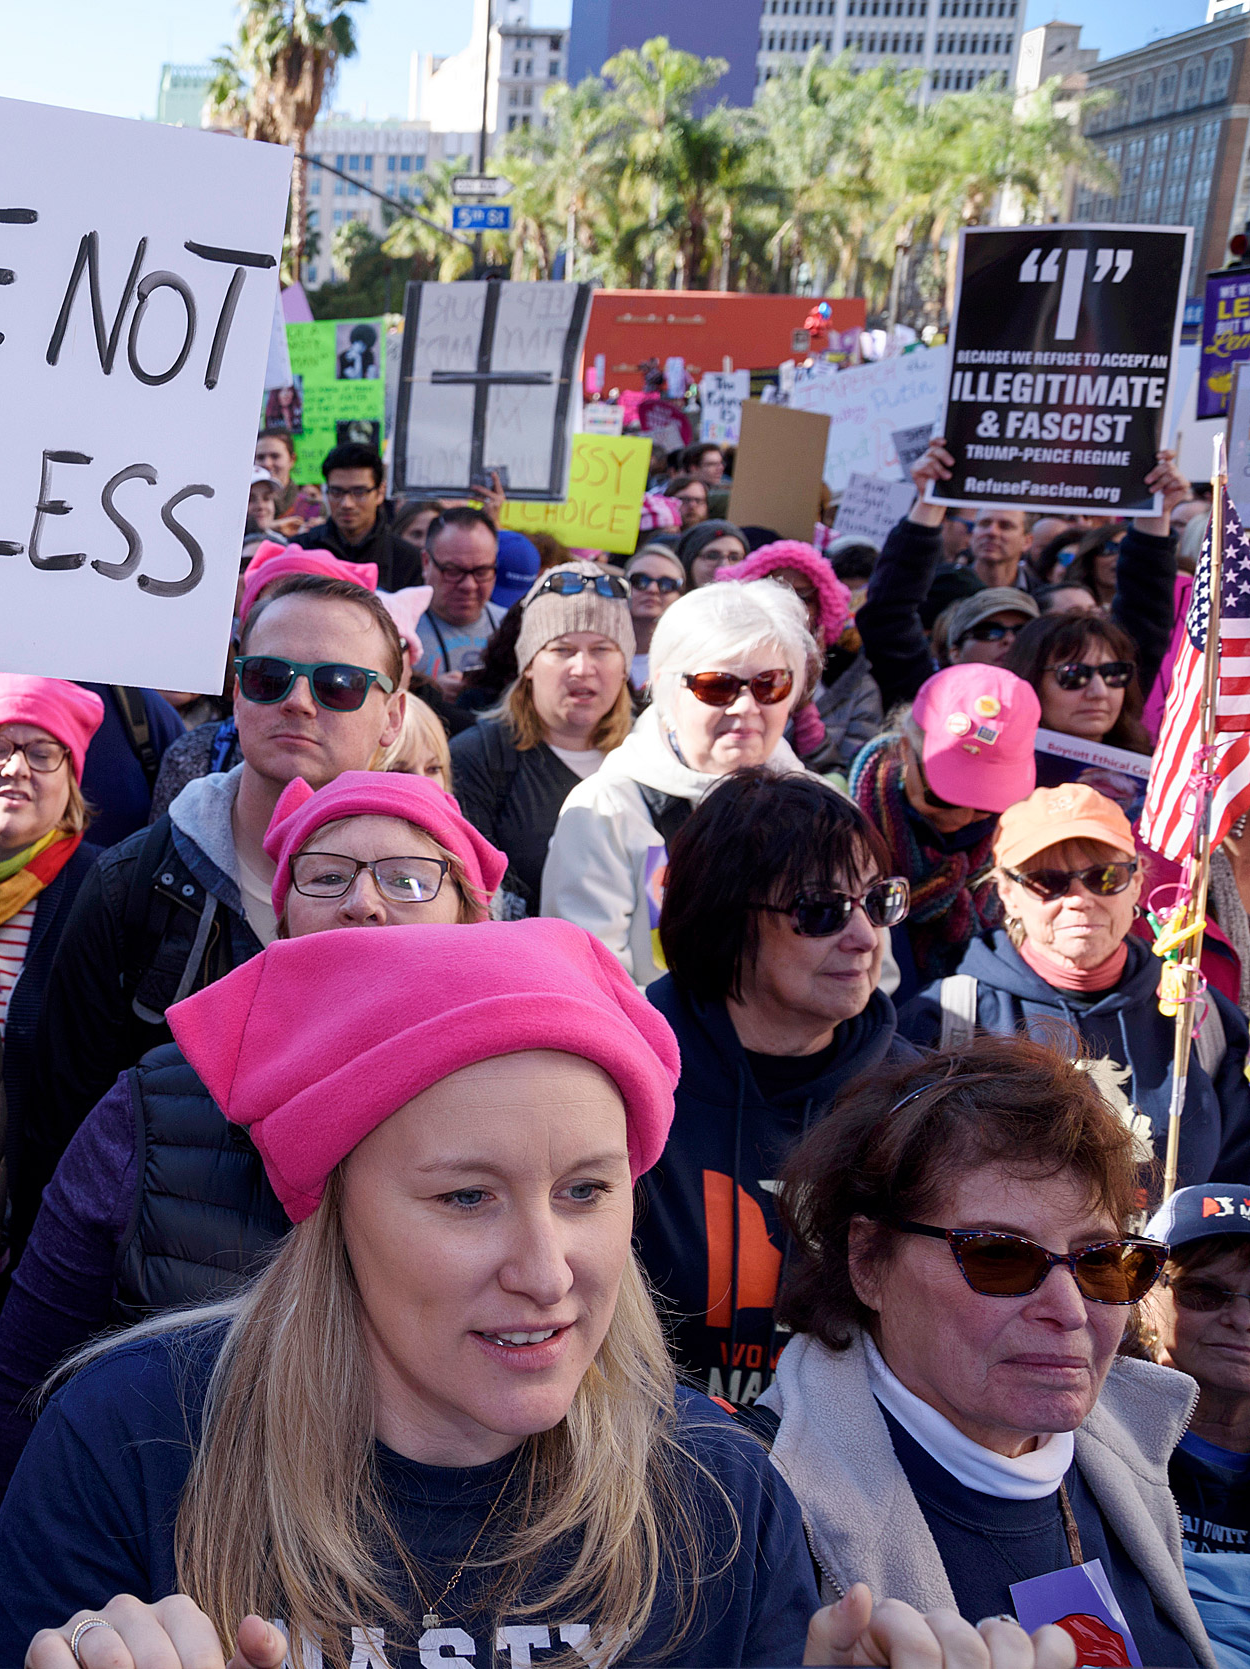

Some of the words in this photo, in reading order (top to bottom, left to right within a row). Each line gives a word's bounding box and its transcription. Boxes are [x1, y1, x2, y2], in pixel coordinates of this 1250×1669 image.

[46, 229, 278, 390] NOT
[956, 350, 1011, 365] BECAUSE
[1011, 351, 1033, 365] WE
[1033, 352, 1082, 367] REFUSE
[1083, 353, 1100, 366] TO
[1101, 353, 1150, 368] ACCEPT
[1150, 355, 1168, 369] AN
[951, 371, 1165, 408] ILLEGITIMATE
[976, 410, 1000, 438] &
[1005, 411, 1132, 443] FASCIST
[966, 444, 1072, 464] TRUMP-PENCE
[1073, 449, 1131, 466] REGIME
[964, 477, 1121, 503] RefuseFascism.org
[1047, 742, 1090, 760] Boycott
[1092, 753, 1130, 771] Ethical
